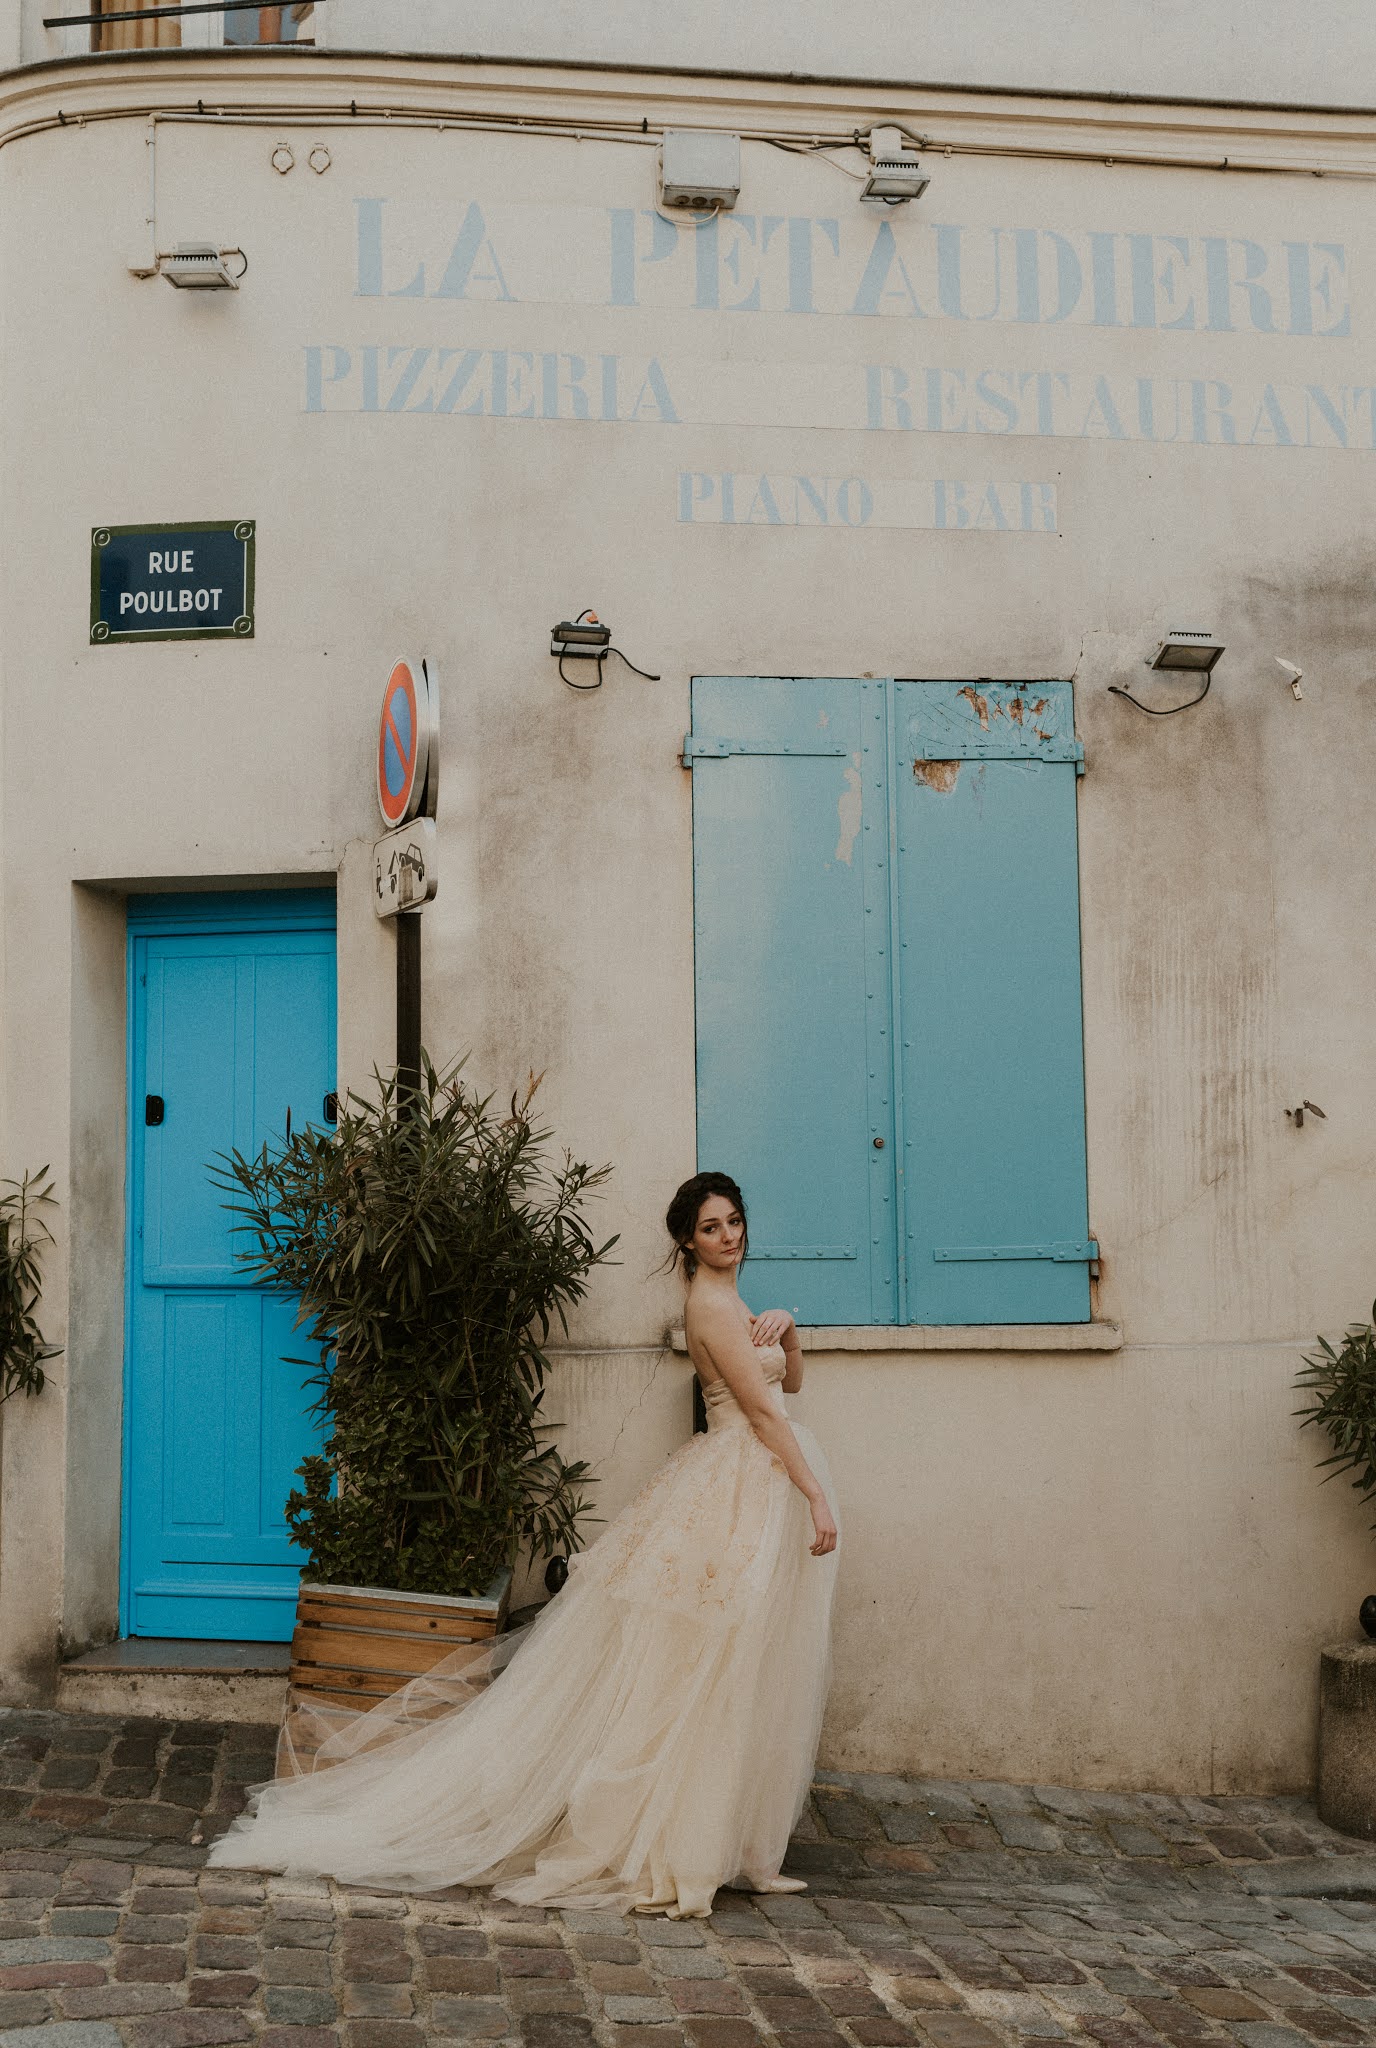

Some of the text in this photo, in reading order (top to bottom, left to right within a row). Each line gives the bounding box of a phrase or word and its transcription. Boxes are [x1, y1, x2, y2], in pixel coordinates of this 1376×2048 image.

[353, 198, 1352, 337] LA PETAUDIERE
[303, 345, 682, 423] PIZZERIA
[677, 472, 1058, 532] PIANO BAR
[148, 550, 194, 574] RUE
[120, 588, 223, 615] POULBOT
